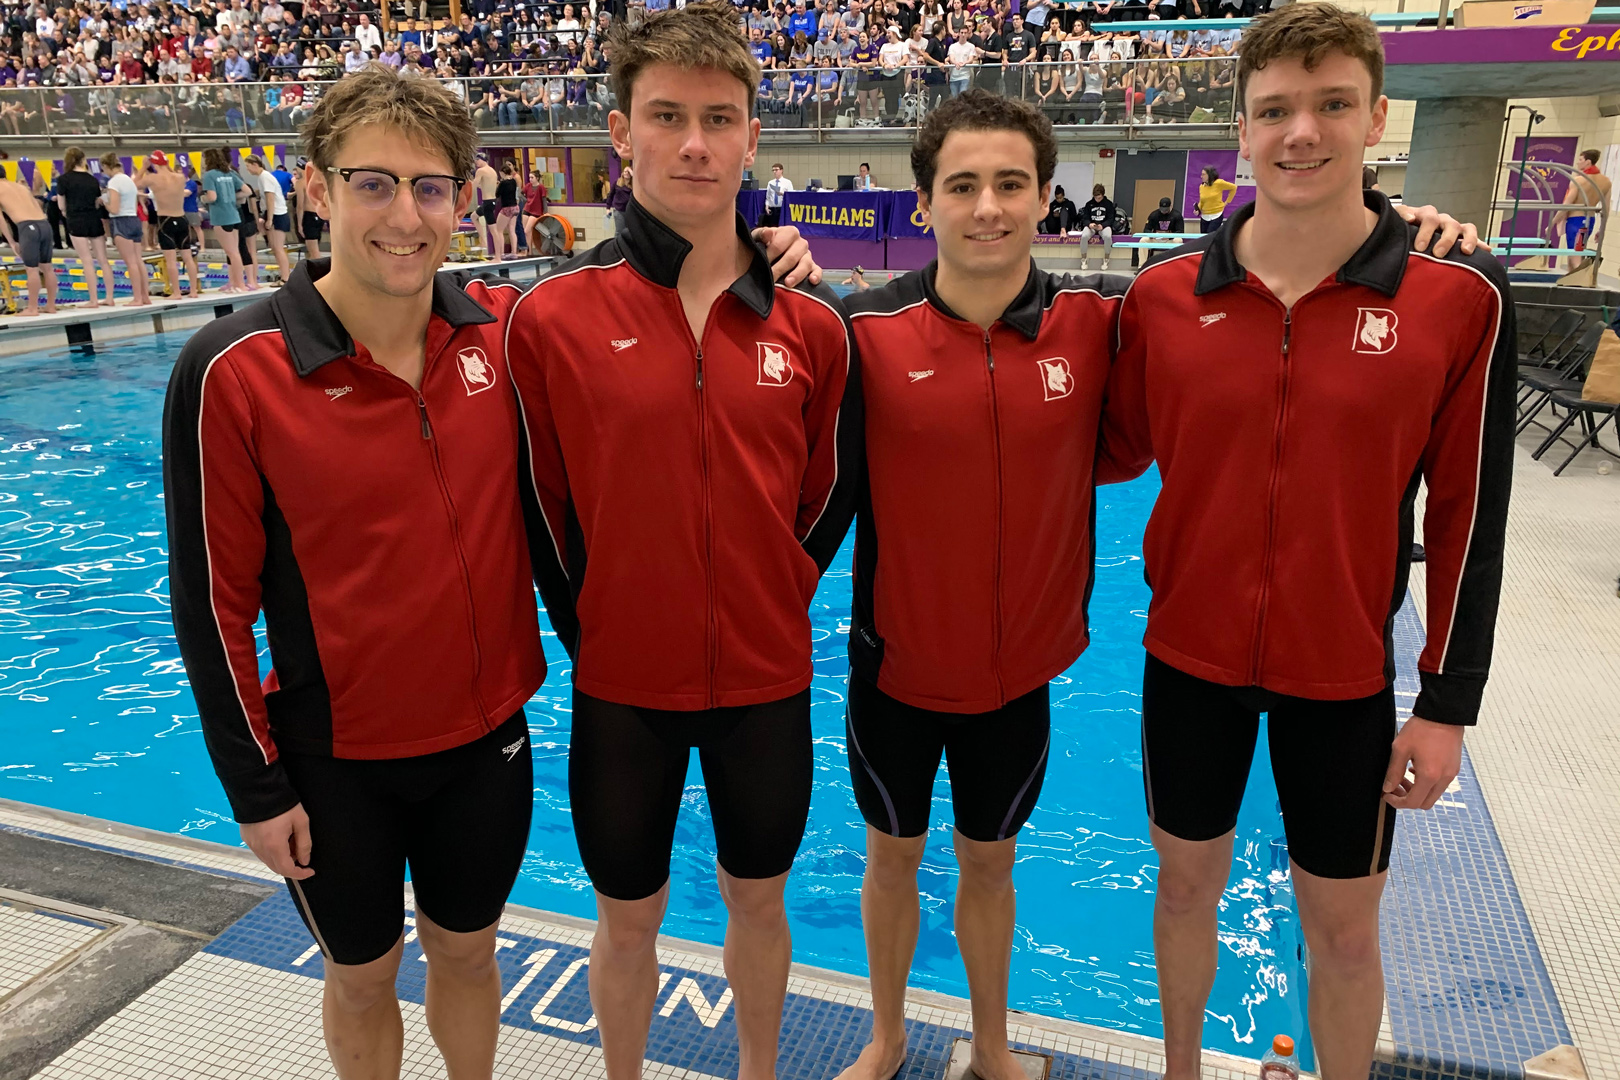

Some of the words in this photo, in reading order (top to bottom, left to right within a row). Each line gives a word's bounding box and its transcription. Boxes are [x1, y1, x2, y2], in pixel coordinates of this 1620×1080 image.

[179, 155, 187, 168] S
[789, 203, 876, 228] WILLIAMS
[1199, 312, 1227, 323] speedo
[611, 337, 638, 349] speedo
[908, 369, 935, 379] speedo
[324, 385, 353, 397] speedo
